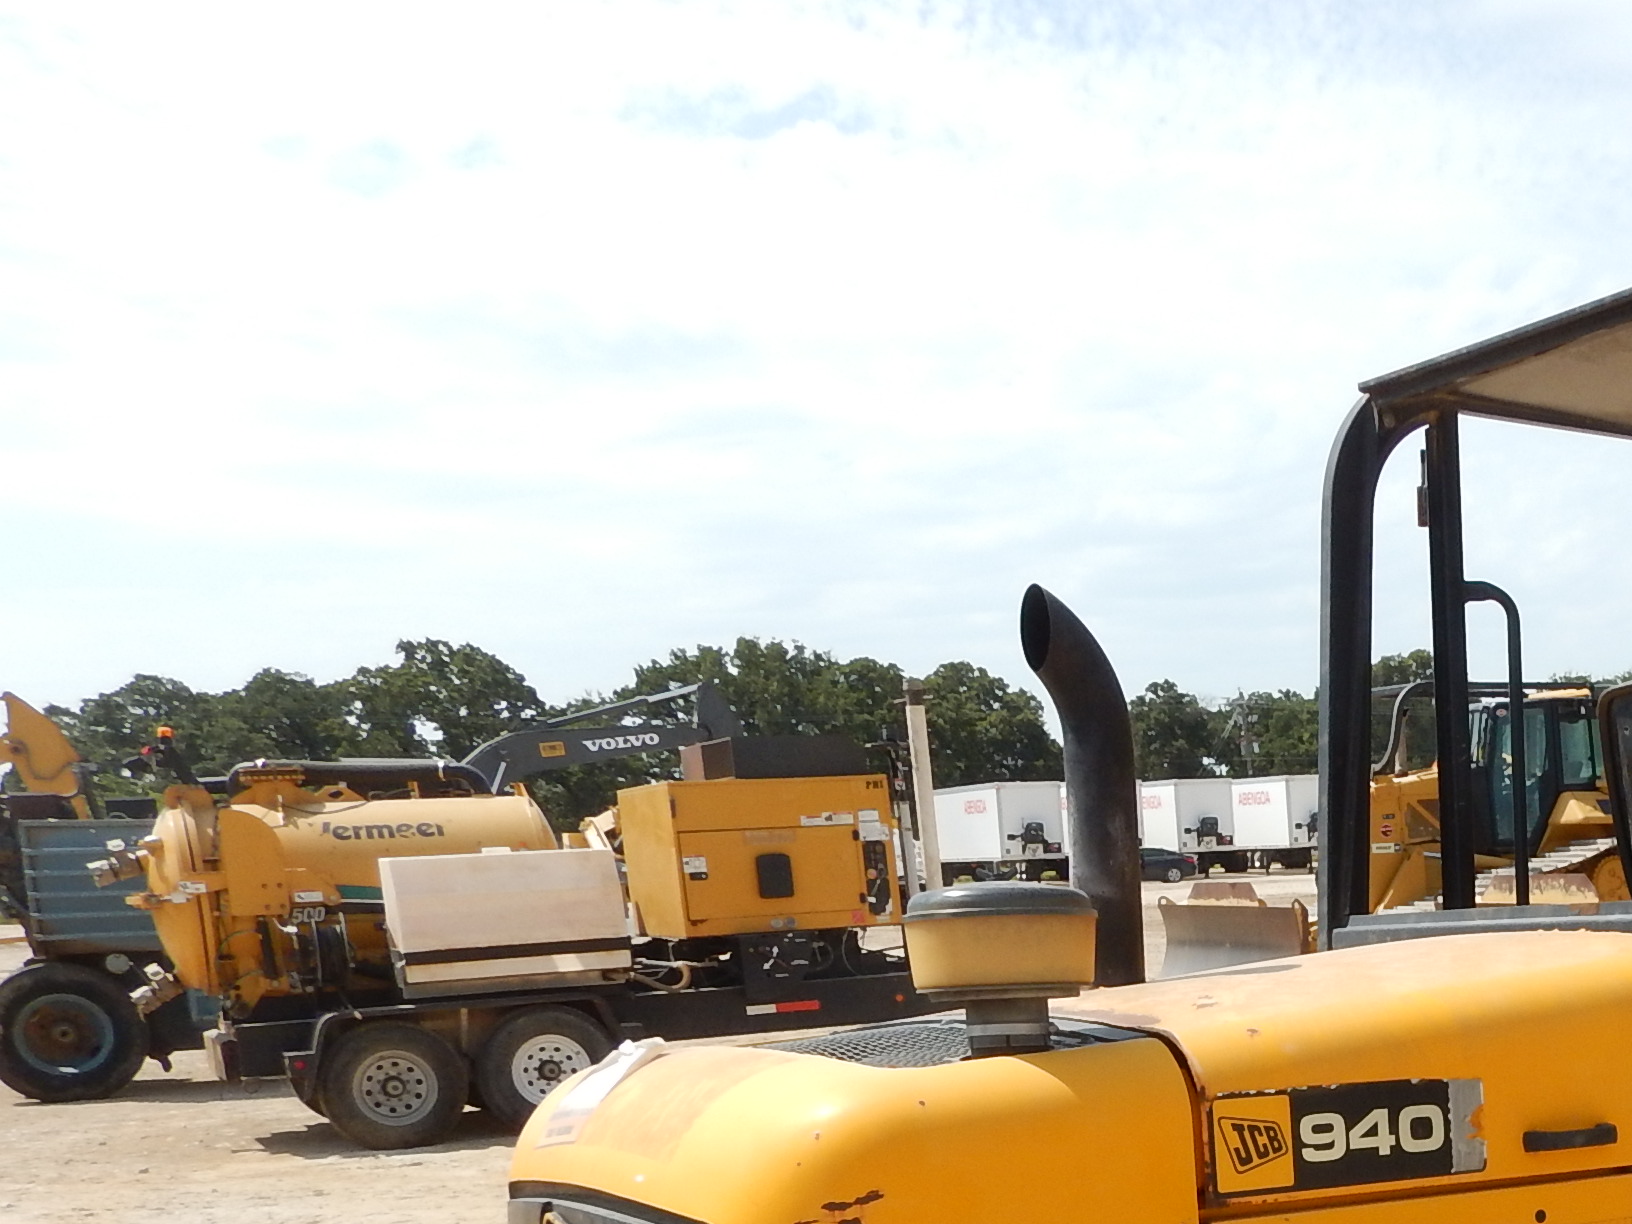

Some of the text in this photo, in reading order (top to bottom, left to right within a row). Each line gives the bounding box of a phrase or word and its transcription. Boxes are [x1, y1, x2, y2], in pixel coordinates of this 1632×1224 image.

[581, 732, 660, 752] VOLVO
[1238, 790, 1271, 806] ABENGOA
[291, 906, 326, 924] 500
[1230, 1104, 1445, 1167] JCB 940
